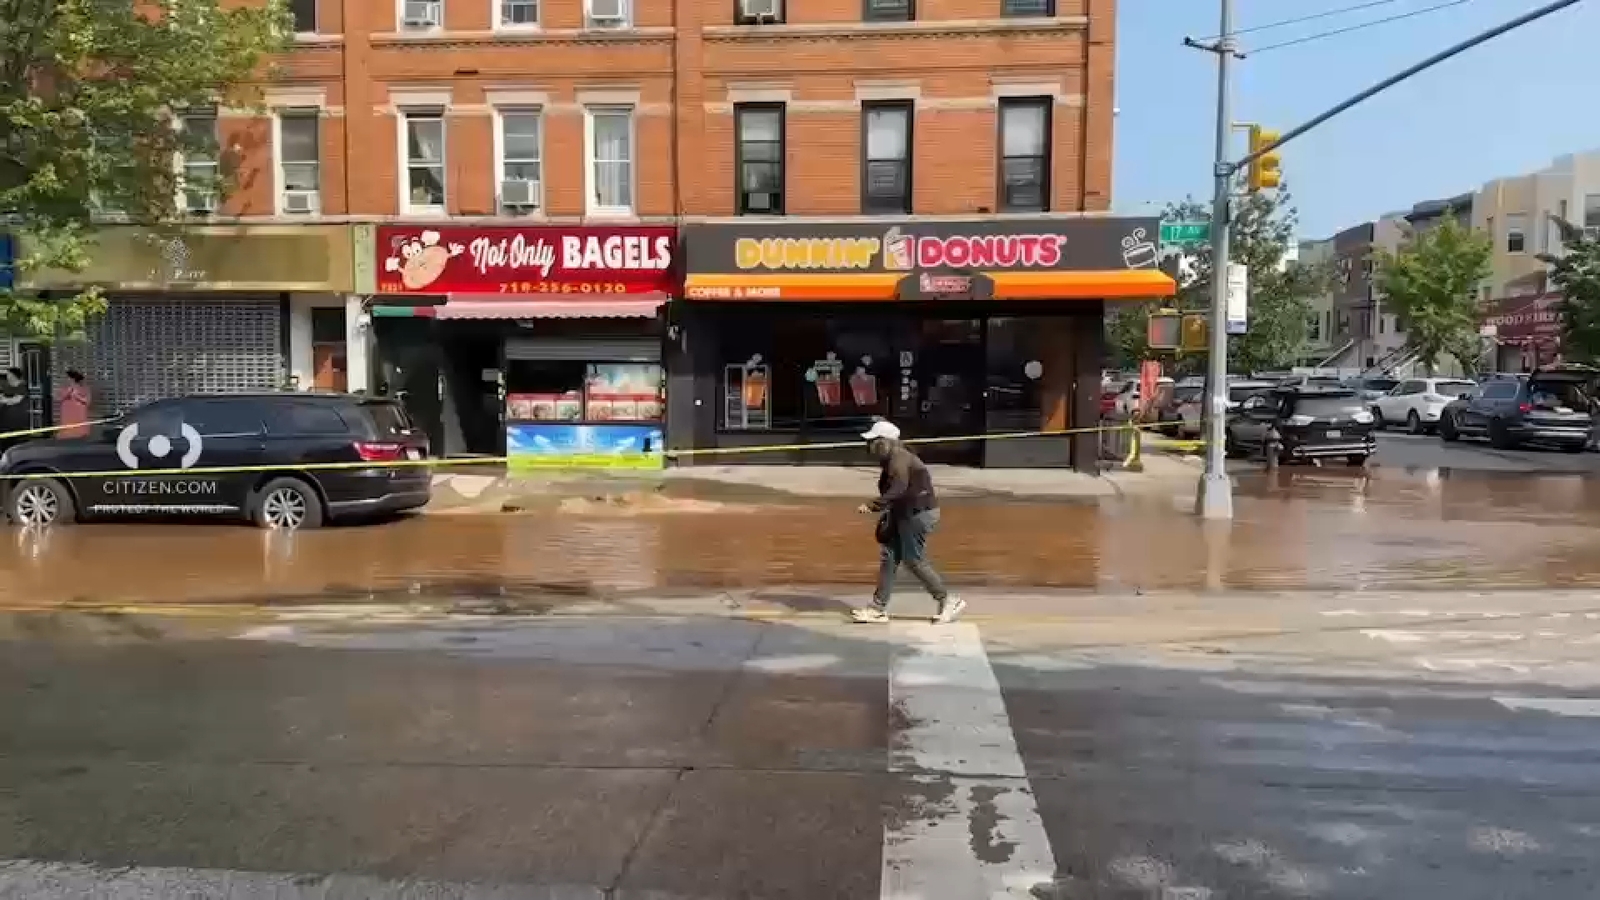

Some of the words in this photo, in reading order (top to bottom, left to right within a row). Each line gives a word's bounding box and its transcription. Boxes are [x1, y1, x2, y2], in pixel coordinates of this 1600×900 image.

[470, 236, 507, 274] Not
[510, 233, 555, 277] Only
[562, 236, 671, 269] BAGELS
[918, 234, 1061, 267] DONUTS
[499, 282, 626, 293] 718-256-0120
